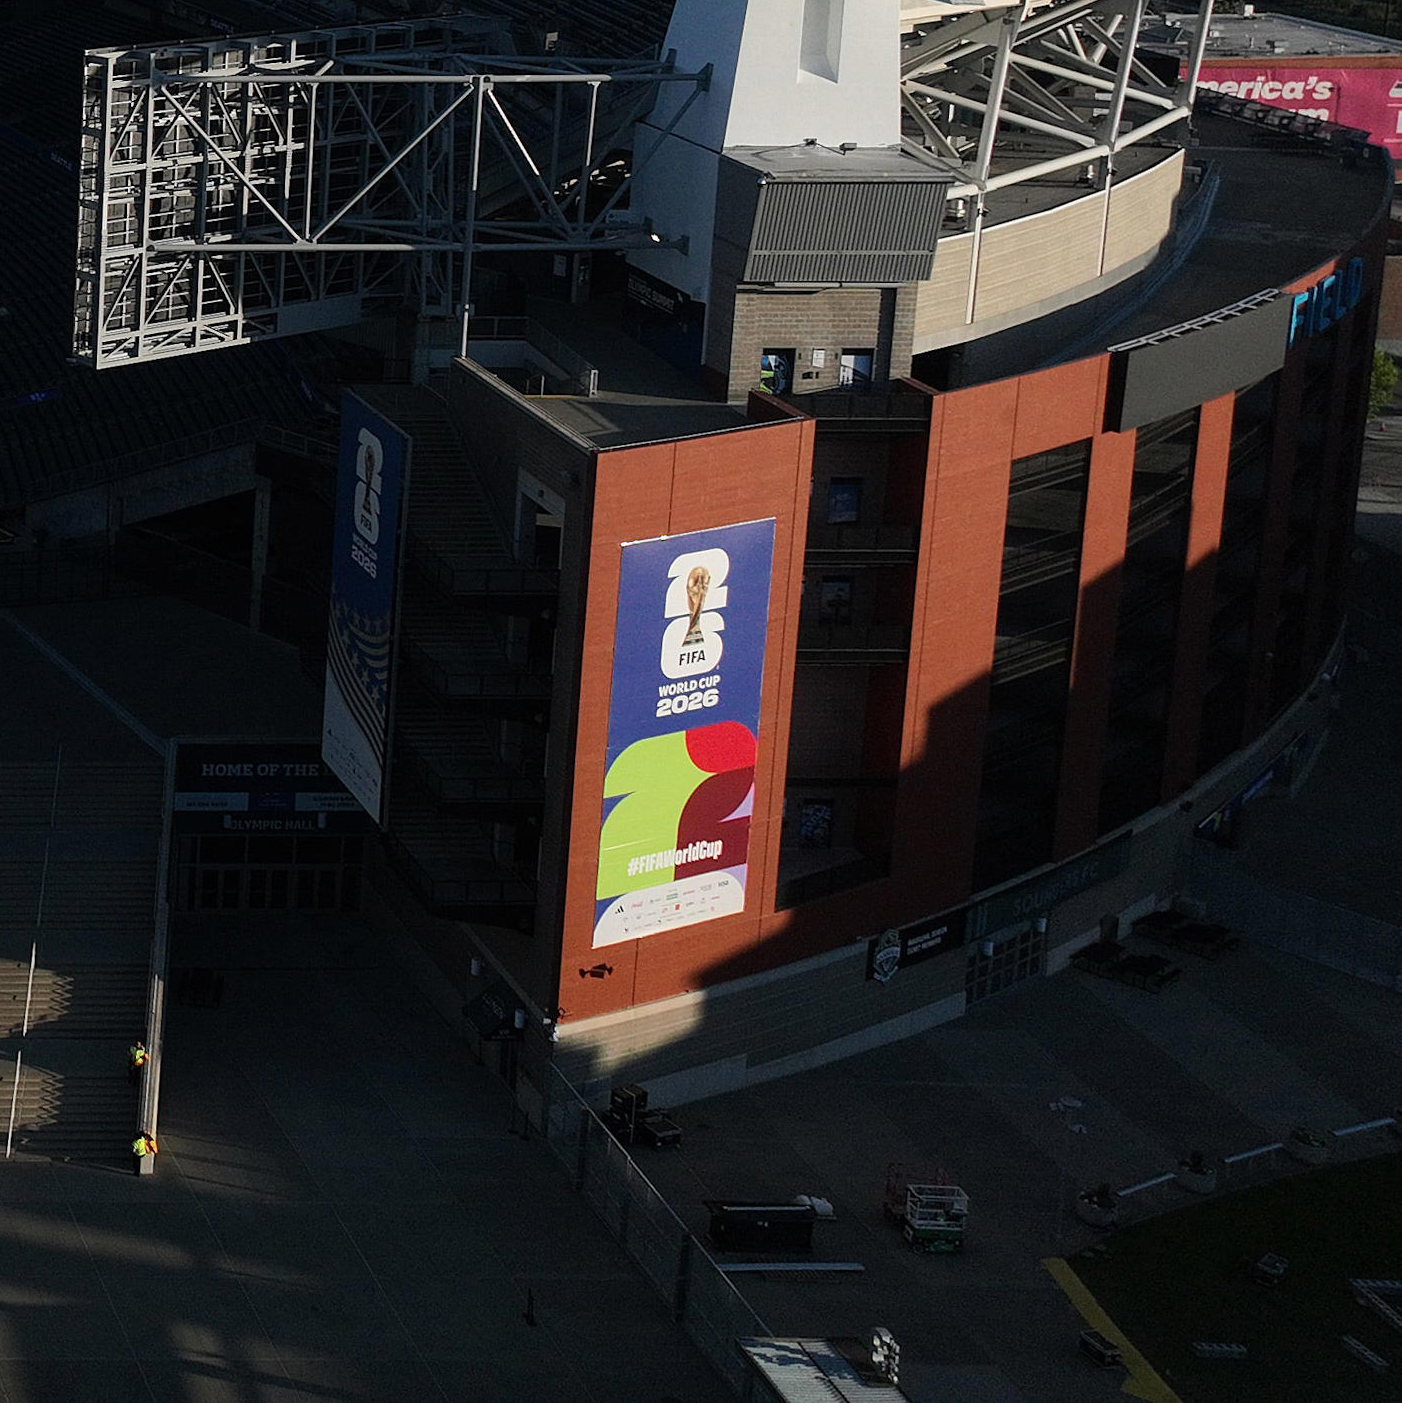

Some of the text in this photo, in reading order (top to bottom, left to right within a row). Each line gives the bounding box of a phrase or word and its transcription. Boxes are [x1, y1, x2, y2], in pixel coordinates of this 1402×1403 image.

[1289, 257, 1363, 344] FIELD
[351, 544, 378, 580] 2026
[679, 650, 706, 666] FIFA
[658, 675, 721, 698] WORLD CUP
[656, 689, 720, 718] 2026
[201, 763, 320, 777] HOME OF THE
[285, 818, 315, 830] HALL
[627, 839, 722, 877] #FIFAWorldCup
